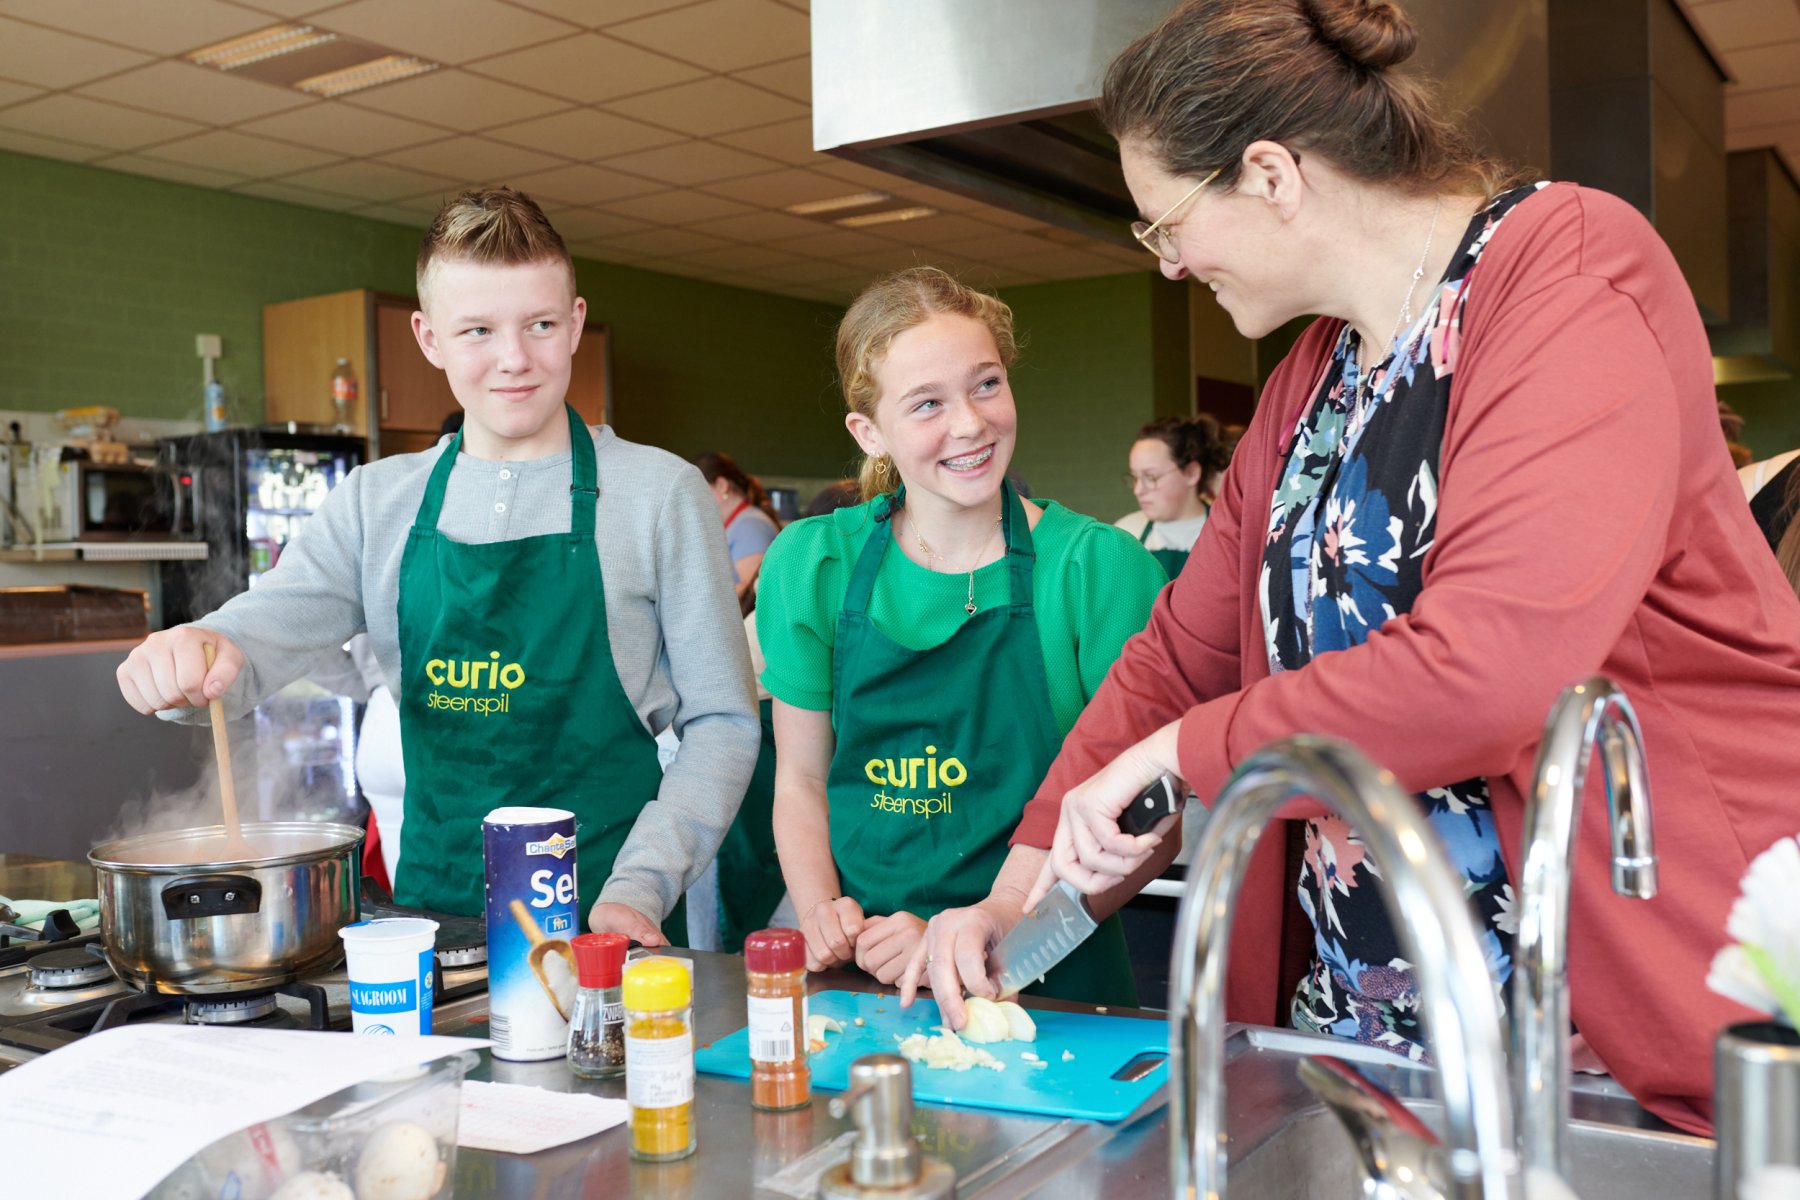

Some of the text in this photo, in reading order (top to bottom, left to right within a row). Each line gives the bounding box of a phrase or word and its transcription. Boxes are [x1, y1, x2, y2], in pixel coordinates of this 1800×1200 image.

[425, 650, 526, 690] curio
[427, 690, 509, 717] steenspil
[864, 745, 968, 789] curio
[870, 790, 952, 820] steenspil
[530, 862, 578, 909] Sel
